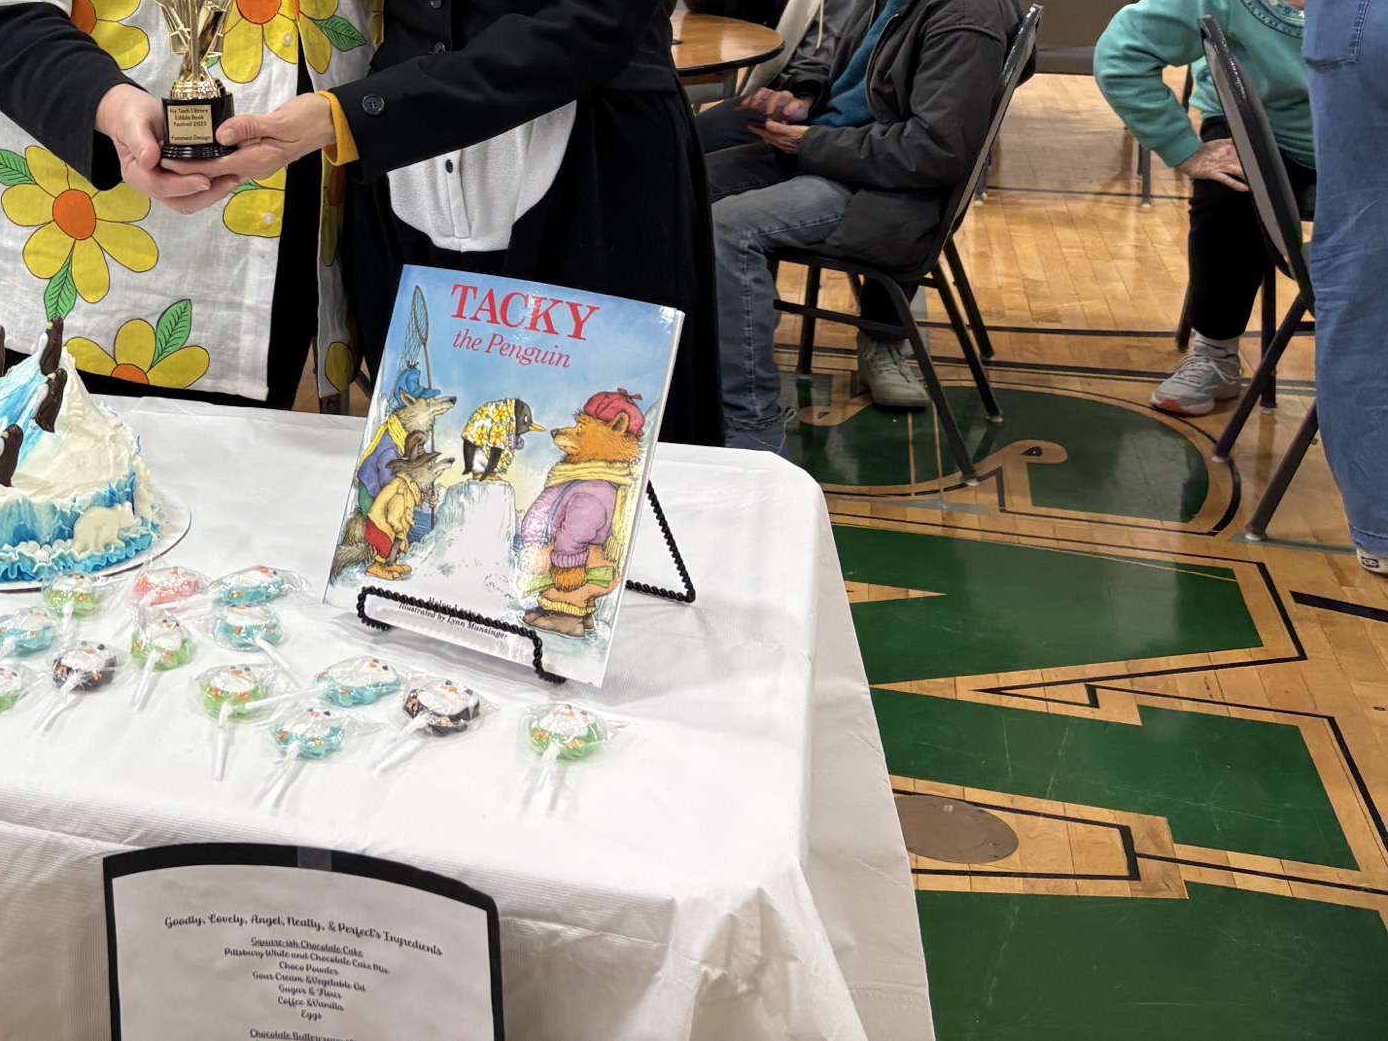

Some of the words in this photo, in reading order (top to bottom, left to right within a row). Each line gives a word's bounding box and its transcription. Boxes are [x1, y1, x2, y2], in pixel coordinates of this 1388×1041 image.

[451, 283, 600, 341] TACKY
[453, 328, 483, 351] the
[484, 332, 571, 368] Penguin
[398, 602, 436, 619] Illustrated
[437, 612, 446, 622] by
[447, 615, 466, 627] Lynn
[467, 621, 509, 639] Munsinger
[164, 915, 206, 929] Goodly,
[208, 913, 248, 926] Lovely,
[251, 914, 285, 927] Angel,
[328, 920, 336, 932] &
[338, 922, 381, 938] Perfect's
[383, 930, 443, 956] Ingredients
[300, 939, 341, 954] Chocolate
[343, 945, 364, 957] Cake
[224, 948, 264, 959] Pillsbury
[265, 949, 290, 958] White
[291, 951, 309, 960] and
[310, 952, 351, 966] Chocolate
[352, 958, 372, 971] Cake
[279, 960, 304, 971] Choco
[306, 964, 339, 975] Powder
[252, 970, 274, 981] Sour
[275, 972, 303, 983] Cream
[278, 984, 306, 996] Sugar
[308, 987, 315, 996] &
[277, 996, 304, 1007] Coffee
[300, 1010, 322, 1021] Eggs
[249, 1028, 291, 1040] Chocolate
